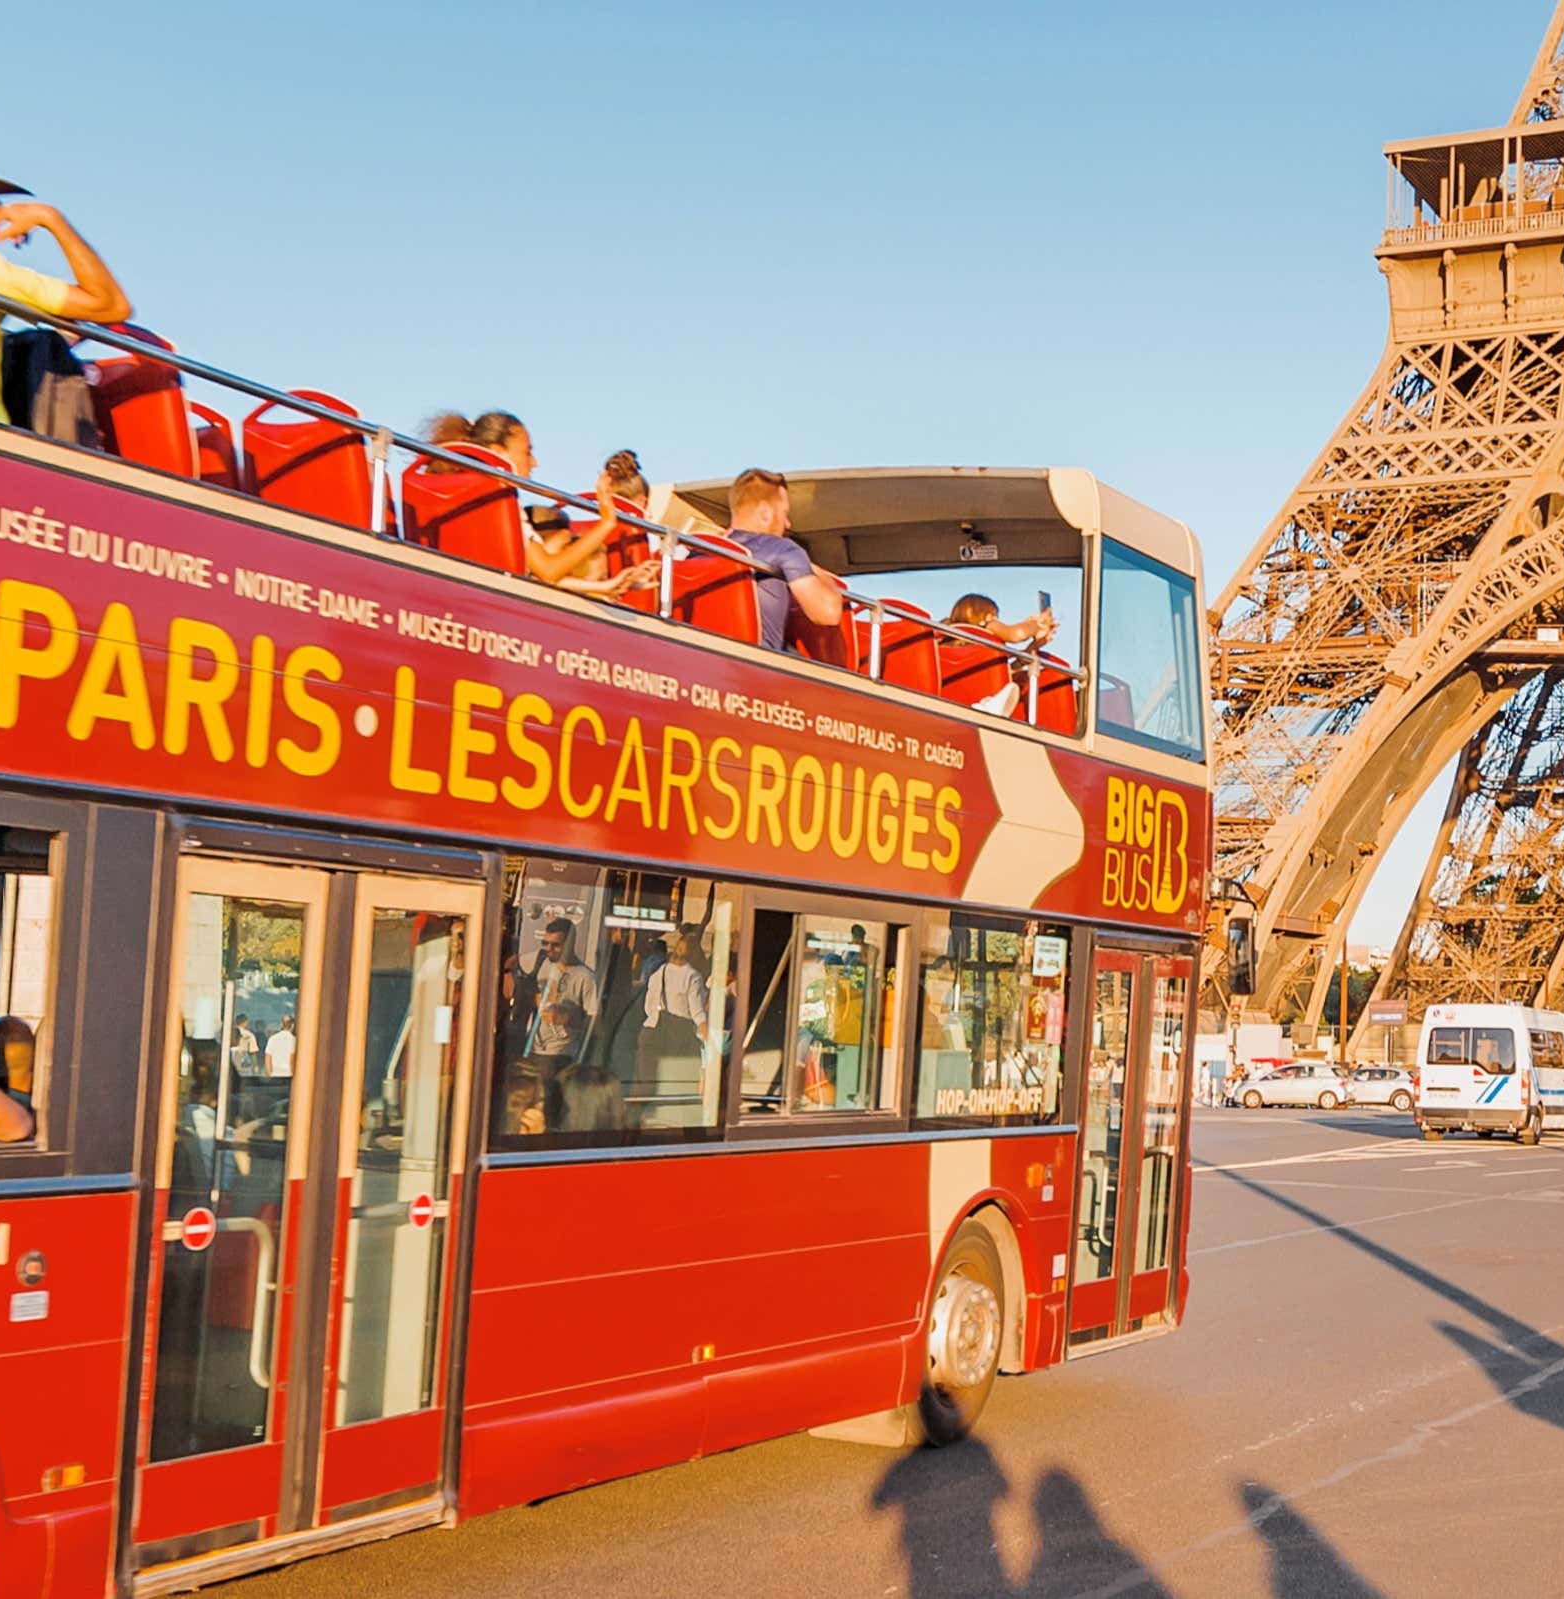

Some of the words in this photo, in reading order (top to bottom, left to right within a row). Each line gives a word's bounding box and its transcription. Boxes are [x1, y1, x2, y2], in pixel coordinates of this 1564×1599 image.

[68, 525, 110, 562] DU
[113, 536, 213, 588] LOUVRE
[235, 567, 380, 629] NOTRE-DAME
[398, 609, 466, 650] MUSÉE
[467, 626, 543, 667] D'ORSAY
[556, 649, 610, 685] OPÉRA
[612, 664, 679, 701] GARNIER
[816, 715, 857, 744] GRAND
[858, 726, 896, 753] PALAIS
[1106, 775, 1155, 849] BIG
[1102, 847, 1153, 912] BUS
